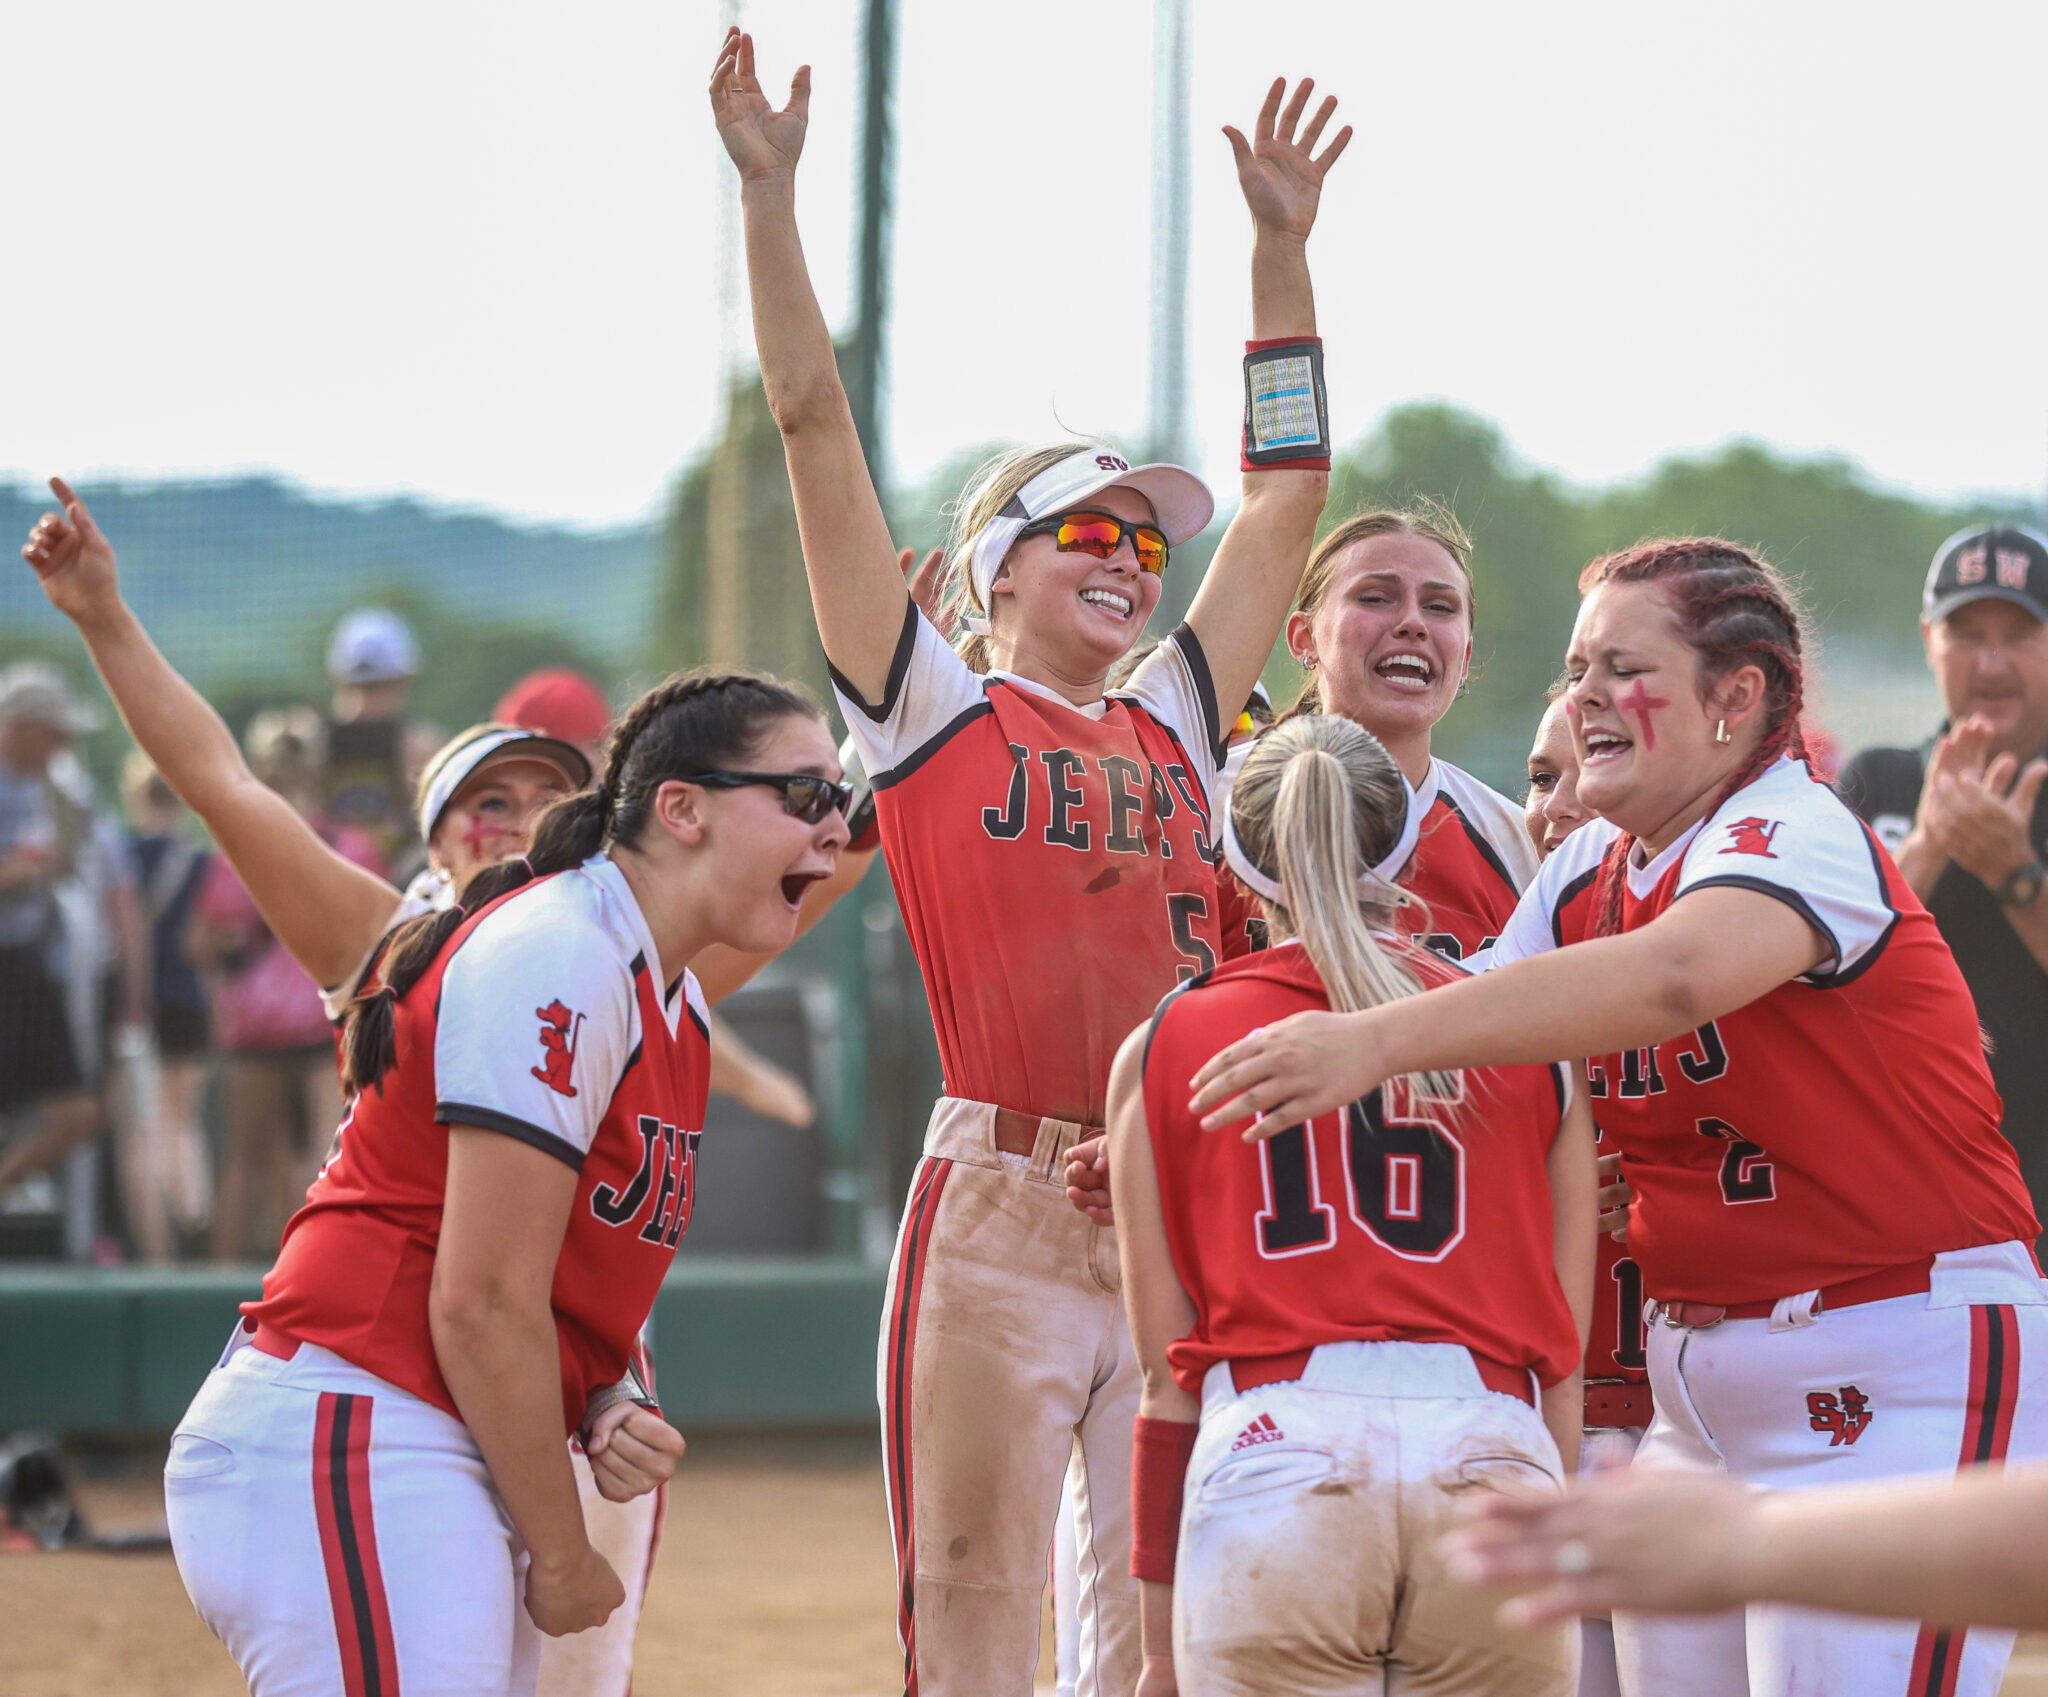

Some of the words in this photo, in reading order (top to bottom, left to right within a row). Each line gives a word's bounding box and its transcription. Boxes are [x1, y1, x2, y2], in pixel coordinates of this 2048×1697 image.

[1166, 892, 1218, 984] 5
[589, 1114, 702, 1250] JEE
[1254, 1069, 1465, 1263] 16
[1695, 1116, 1777, 1205] 2
[1231, 1431, 1284, 1452] adidas
